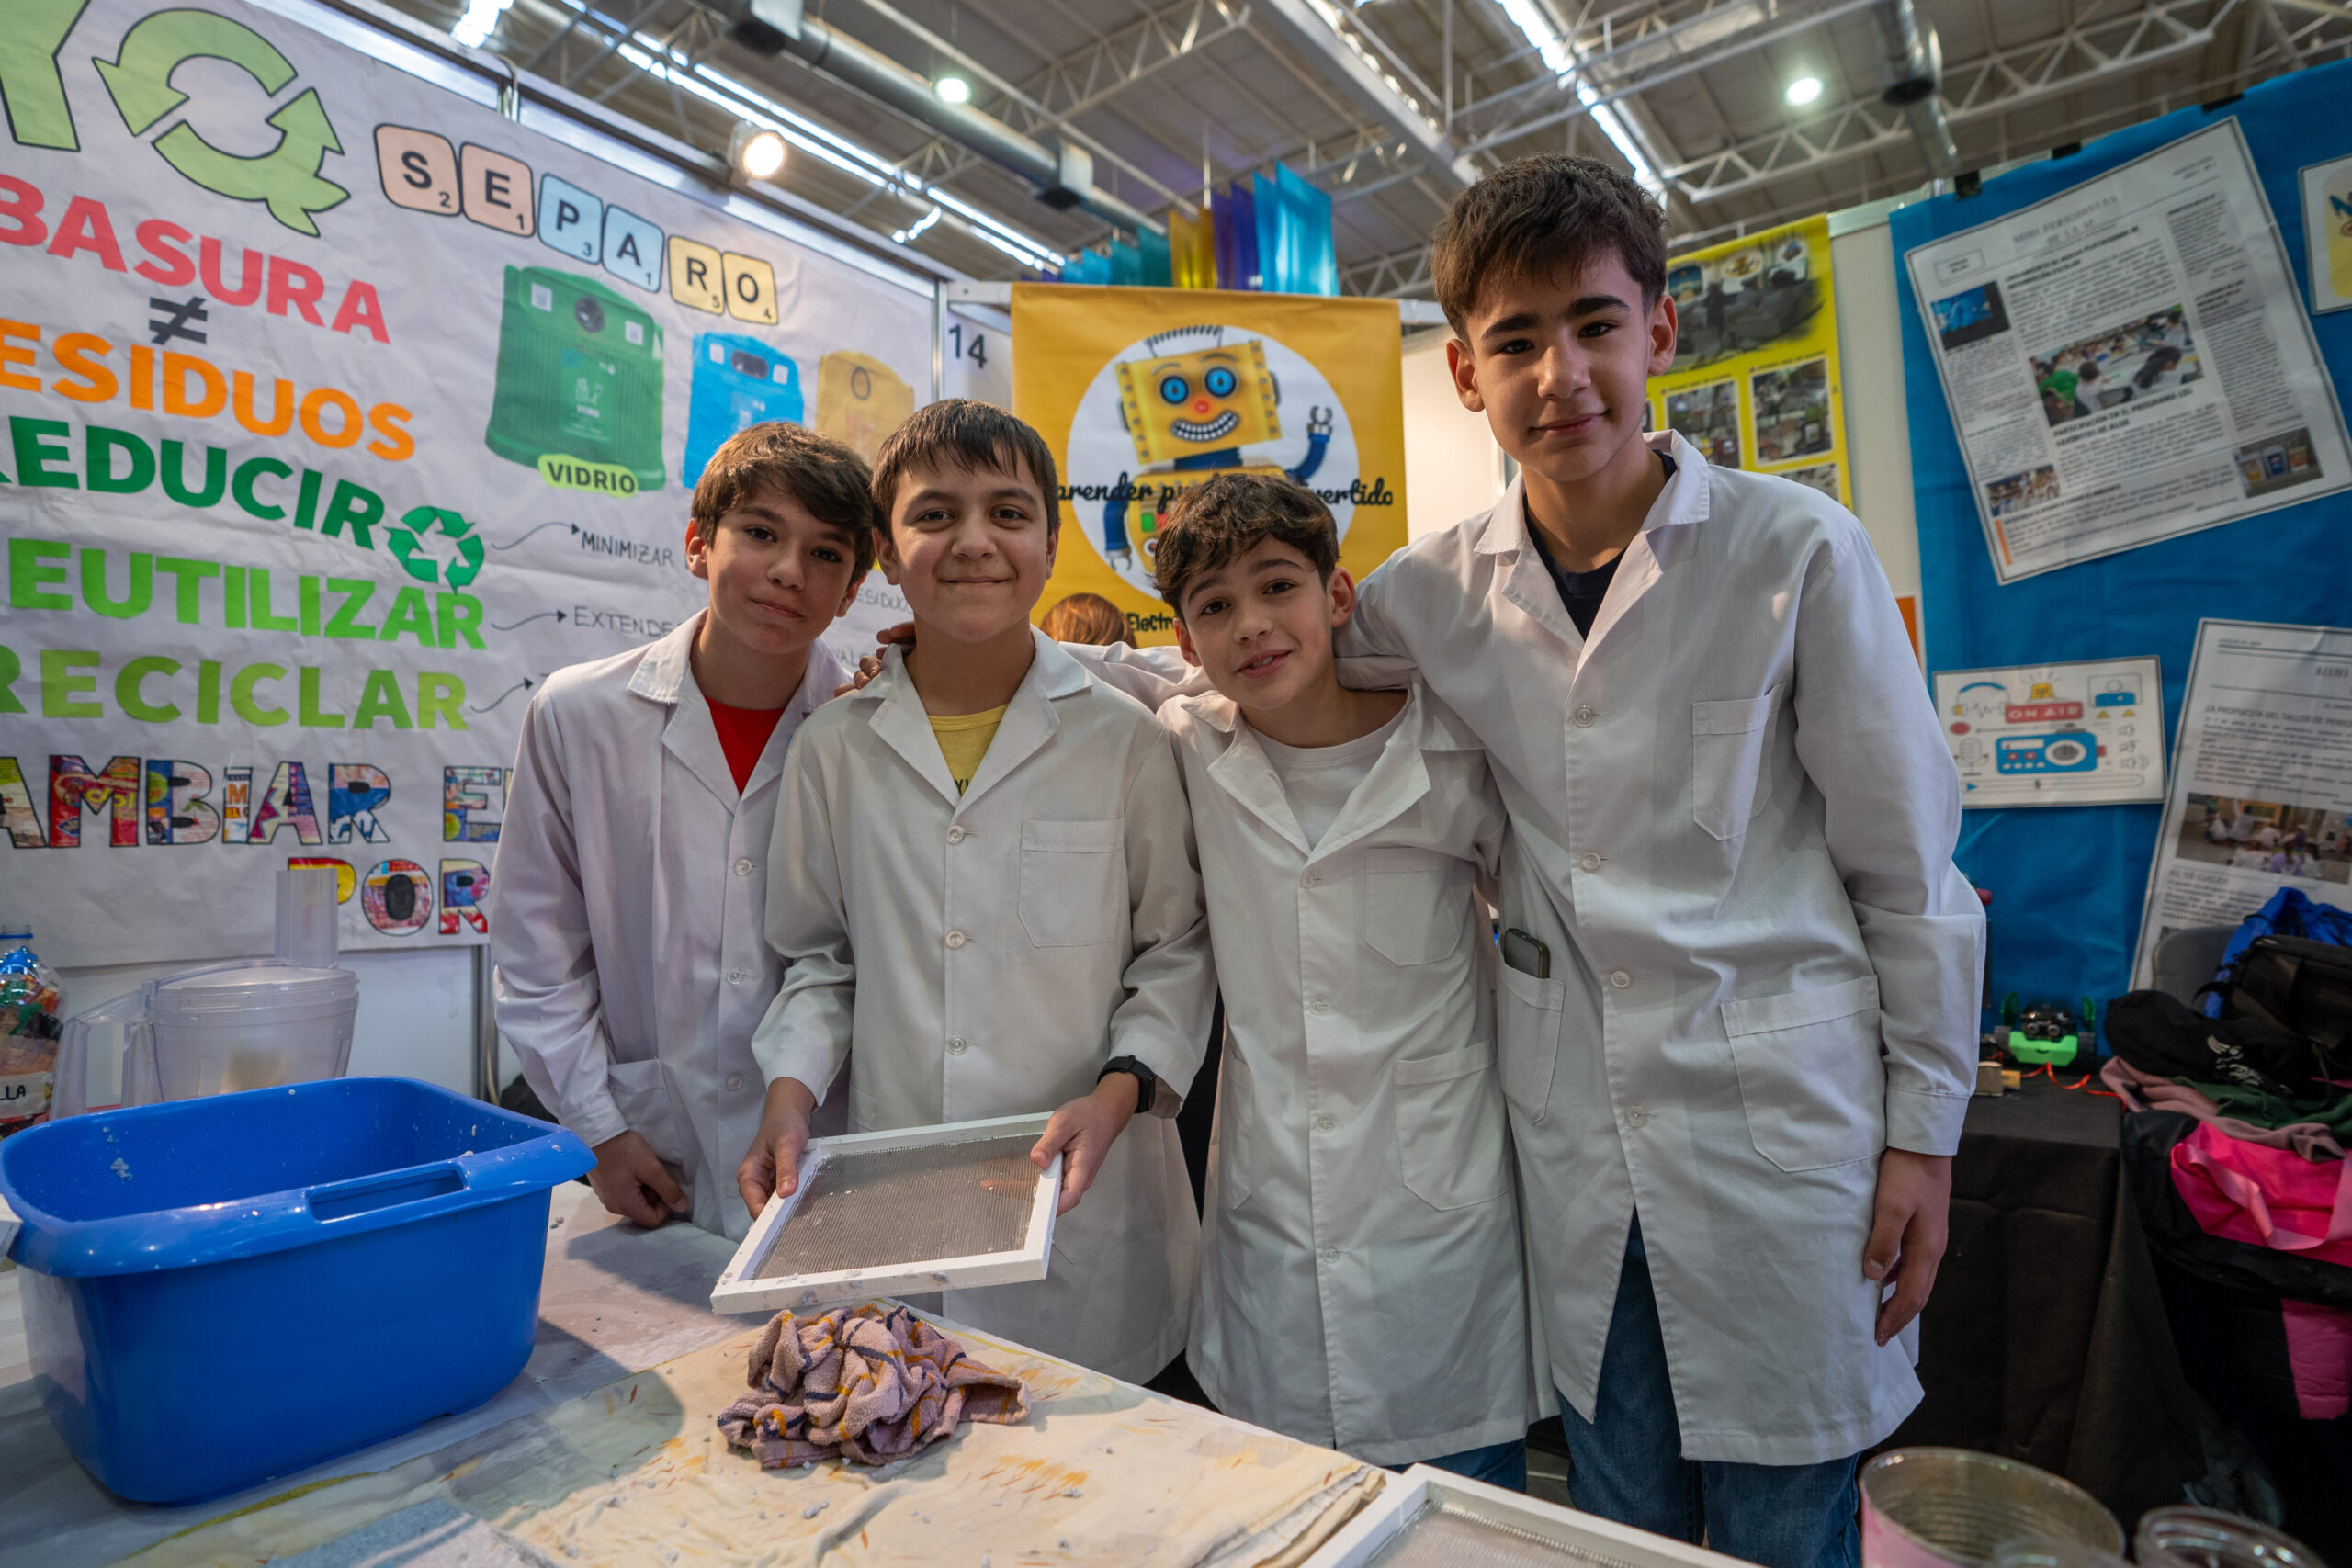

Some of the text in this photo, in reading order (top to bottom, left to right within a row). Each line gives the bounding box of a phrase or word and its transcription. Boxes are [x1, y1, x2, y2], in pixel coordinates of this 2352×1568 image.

[0, 173, 392, 346] BASURA
[948, 323, 989, 370] 14
[0, 415, 386, 550] EDUCIR
[548, 462, 636, 496] VIDRIO
[581, 529, 675, 569] MINIMIZAR
[0, 537, 488, 650] EUTILIZAR
[573, 605, 682, 638] EXTENDE
[443, 765, 513, 842] E
